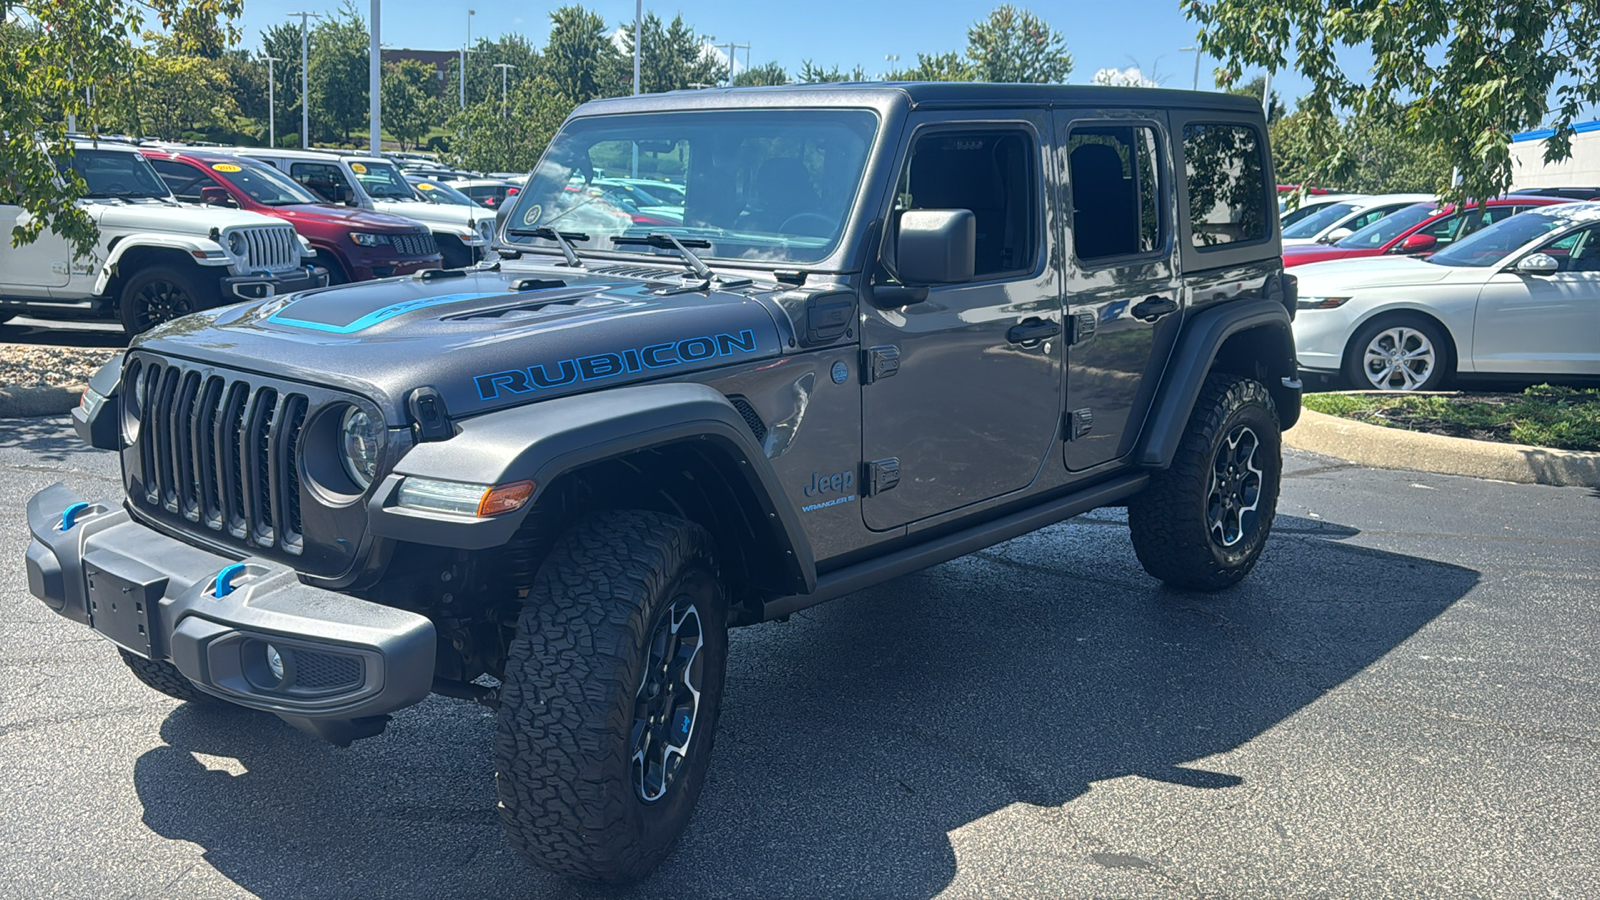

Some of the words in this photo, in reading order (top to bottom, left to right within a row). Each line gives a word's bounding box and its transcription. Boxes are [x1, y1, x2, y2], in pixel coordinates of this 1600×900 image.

[473, 329, 757, 401] RUBICON
[804, 471, 853, 497] Jeep
[802, 496, 847, 512] WRANGLER
